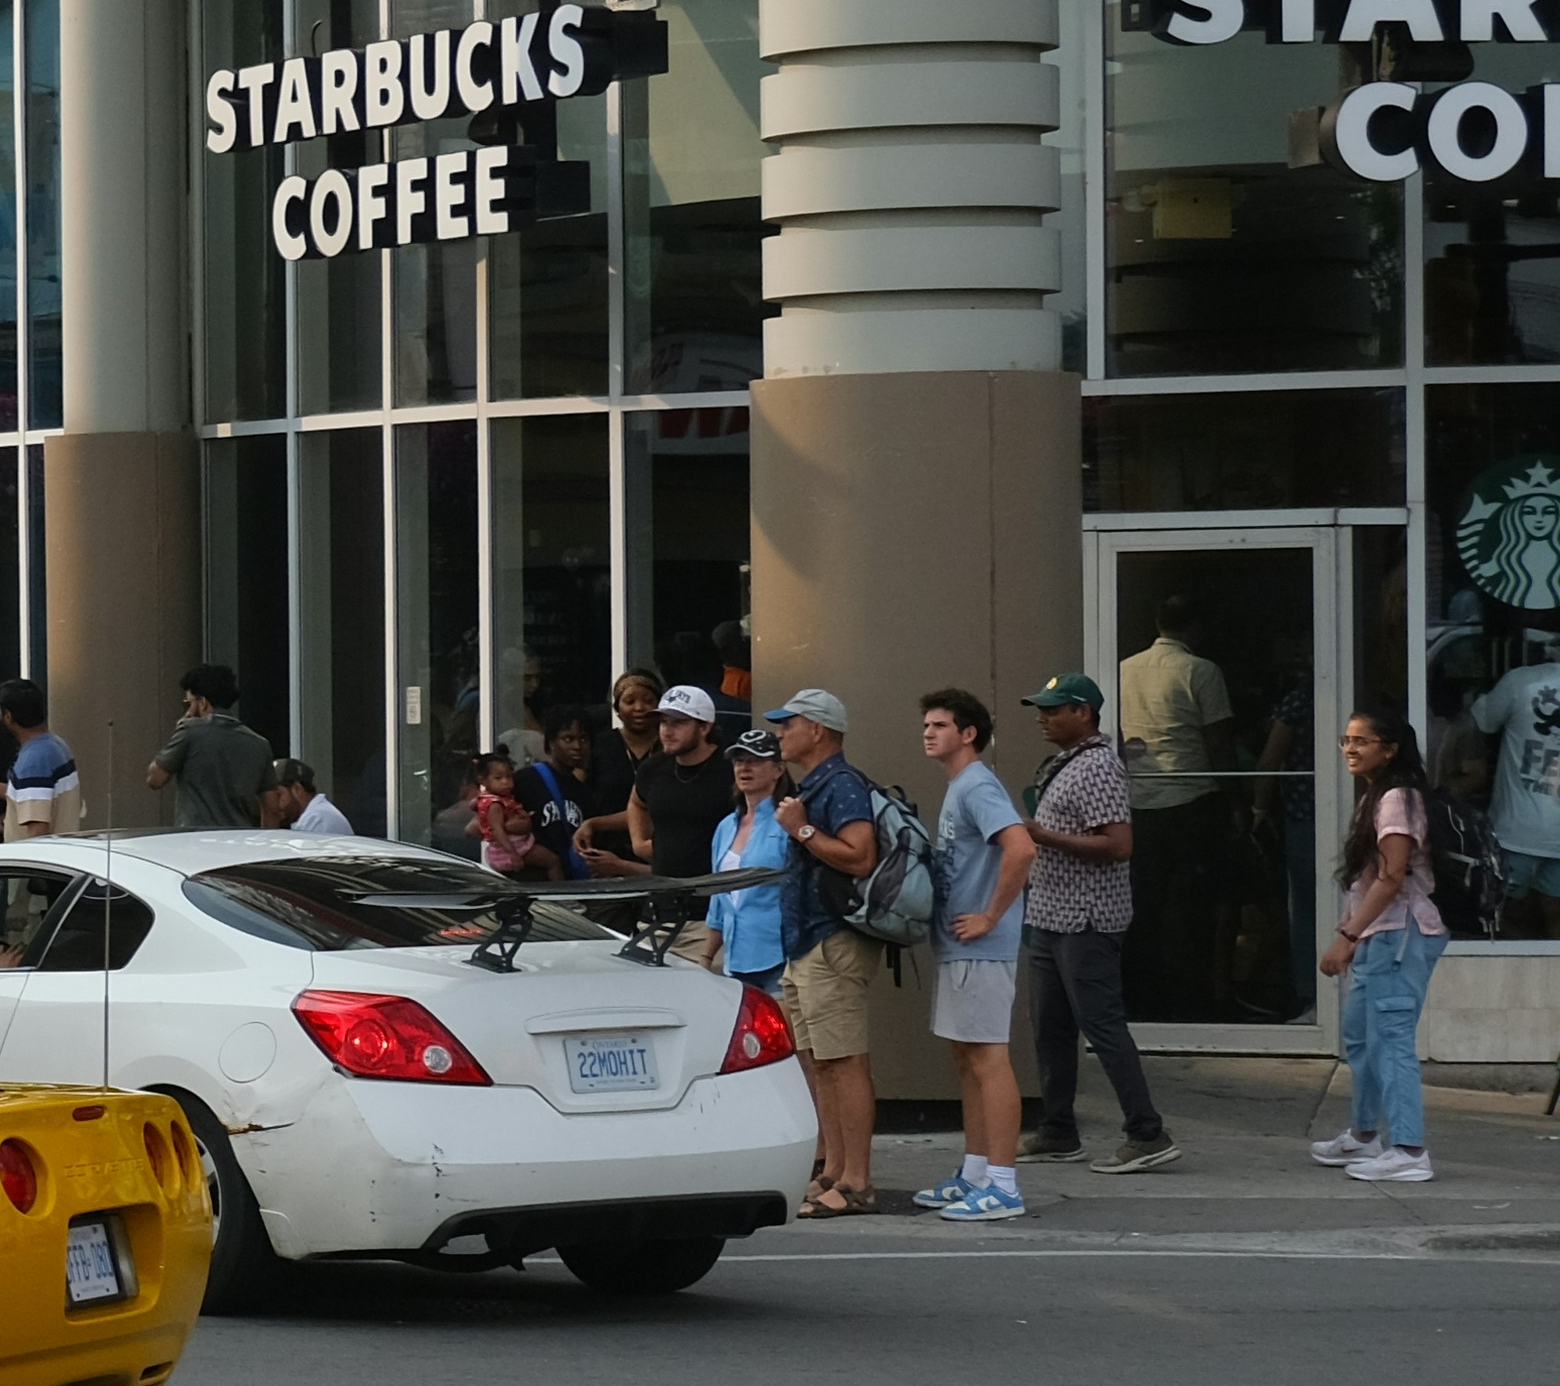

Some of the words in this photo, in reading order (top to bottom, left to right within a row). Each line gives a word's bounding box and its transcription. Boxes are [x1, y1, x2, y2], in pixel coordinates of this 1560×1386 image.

[206, 3, 584, 154] STARBUCKS
[1336, 82, 1560, 181] CO
[273, 145, 509, 261] COFFEE
[577, 1049, 647, 1078] 22MOHIT
